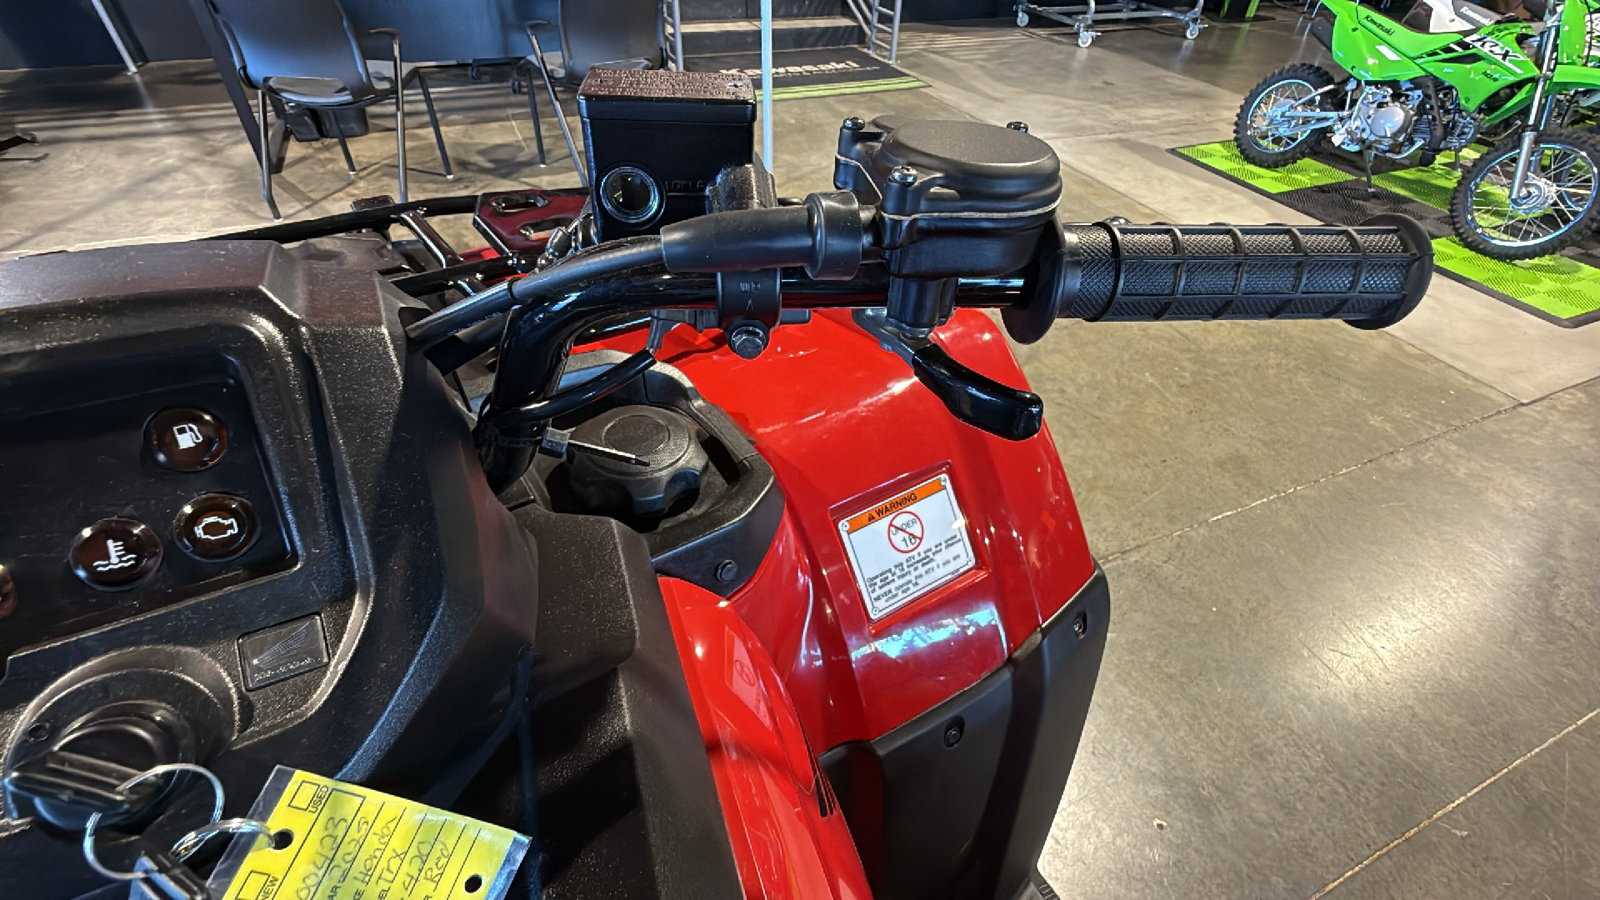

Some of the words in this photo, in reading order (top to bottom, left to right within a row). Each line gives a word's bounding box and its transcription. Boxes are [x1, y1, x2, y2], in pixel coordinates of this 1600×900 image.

[1364, 14, 1395, 36] Kawasaki
[875, 492, 917, 517] WARNING
[891, 518, 917, 536] UNDER
[902, 533, 917, 549] 16
[867, 567, 892, 583] Operating
[893, 561, 903, 570] this
[906, 555, 916, 563] ATV
[923, 547, 933, 556] you
[944, 535, 957, 544] under
[874, 589, 892, 601] NEVER
[925, 567, 935, 575] ATV
[942, 559, 951, 567] you
[880, 576, 889, 584] age
[897, 570, 911, 581] injury
[309, 785, 330, 813] USED
[354, 817, 396, 884] Honda
[424, 842, 452, 883] Red
[403, 841, 432, 891] 420
